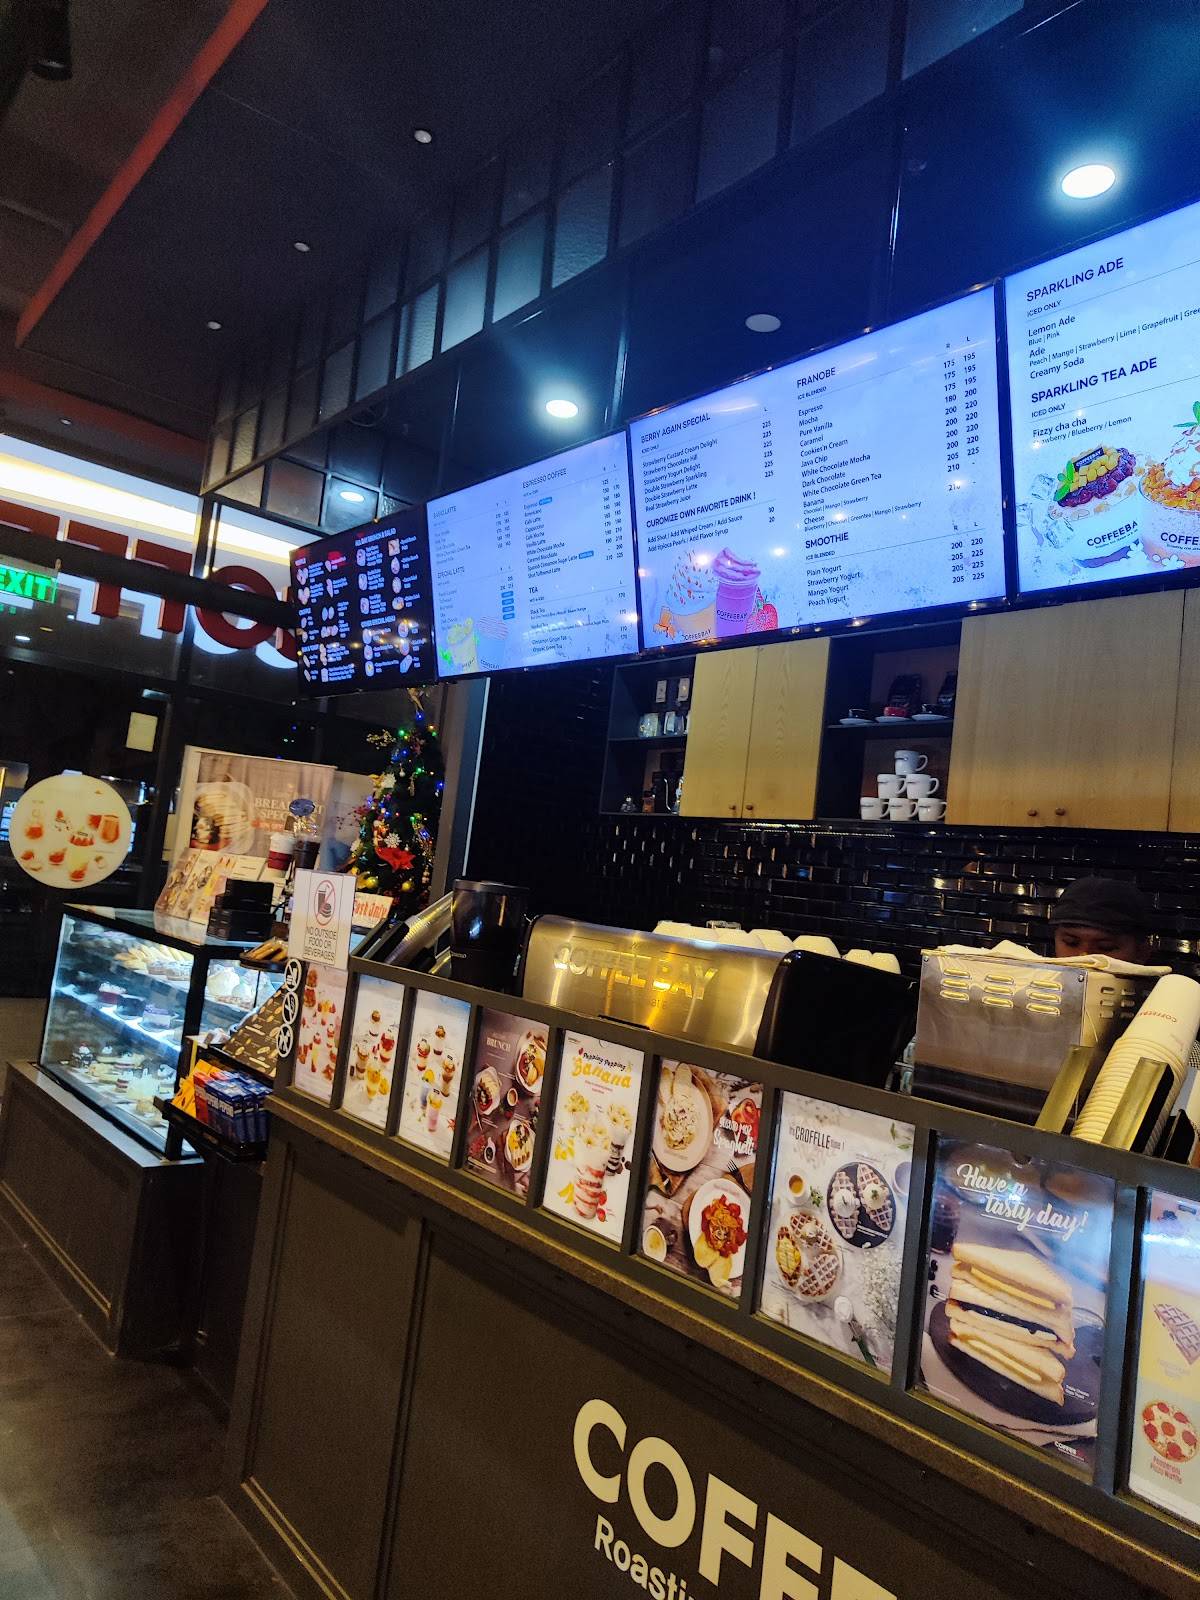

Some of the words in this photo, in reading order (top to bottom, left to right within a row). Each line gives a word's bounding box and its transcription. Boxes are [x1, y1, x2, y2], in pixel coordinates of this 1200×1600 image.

[1026, 269, 1095, 301] SPARKLING
[1097, 257, 1125, 277] ADE
[1027, 304, 1043, 317] ICED
[1043, 300, 1061, 311] ONLY
[1028, 322, 1057, 337] Lemon
[1058, 315, 1076, 327] Ade
[1028, 335, 1042, 346] Blue
[1046, 331, 1060, 341] Pink
[1029, 357, 1048, 367] Peach
[1052, 347, 1074, 360] Mango
[1078, 334, 1115, 351] Strawberry
[1119, 328, 1137, 338] Lime
[1141, 314, 1179, 332] Grapefruit
[1029, 347, 1046, 358] Ade
[1030, 363, 1061, 379] Creamy
[1063, 356, 1085, 370] Soda
[796, 367, 836, 388] FRANOBE
[798, 404, 823, 417] Espresso
[943, 360, 955, 369] 175
[963, 352, 976, 362] 195
[1031, 375, 1099, 403] SPARKLING
[1101, 367, 1127, 382] TEA
[1130, 357, 1157, 375] ADE
[799, 416, 818, 427] Mocha
[944, 371, 956, 380] 175
[964, 364, 976, 374] 195
[799, 428, 813, 437] Pure
[814, 421, 833, 433] Vanilla
[944, 383, 956, 392] 175
[964, 376, 977, 386] 195
[1031, 407, 1047, 418] ICED
[1048, 403, 1066, 413] ONLY
[641, 431, 660, 443] BERRY
[661, 423, 682, 436] AGAIN
[682, 413, 711, 428] SPECIAL
[800, 435, 824, 447] Caramel
[944, 394, 957, 403] 180
[964, 388, 977, 397] 200
[828, 439, 848, 449] Cream
[945, 406, 957, 415] 200
[965, 399, 978, 409] 220
[1032, 426, 1053, 438] Fizzy
[1055, 422, 1070, 431] cha
[1072, 417, 1087, 427] cha
[1071, 424, 1103, 437] Blueberry
[1108, 416, 1132, 426] Lemon
[801, 459, 814, 468] Java
[814, 455, 828, 466] Chip
[945, 418, 958, 427] 200
[965, 411, 978, 421] 220
[802, 467, 819, 478] White
[819, 460, 849, 474] Chocolate
[850, 454, 871, 465] Mocha
[946, 429, 958, 438] 200
[966, 423, 979, 433] 220
[802, 478, 816, 488] Dark
[816, 471, 846, 485] Chocolate
[946, 441, 959, 450] 200
[966, 435, 979, 445] 220
[802, 487, 820, 498] White
[820, 480, 850, 494] Chocolate
[850, 475, 870, 486] Green
[870, 472, 882, 482] Tea
[947, 452, 959, 461] 205
[967, 447, 980, 456] 225
[803, 498, 825, 508] Banana
[947, 463, 960, 472] 210
[843, 495, 869, 505] Strawberry
[680, 508, 696, 519] OWN
[697, 500, 729, 514] FAVORITE
[730, 494, 752, 505] DRINK
[803, 515, 825, 525] Cheese
[894, 500, 922, 512] Strawberry
[805, 532, 849, 549] SMOOTHIE
[807, 569, 821, 577] Plain
[822, 565, 842, 575] Yogurt
[951, 541, 962, 549] 200
[807, 575, 839, 587] Strawberry
[840, 571, 860, 581] Yogurt
[972, 549, 983, 557] 225
[529, 586, 538, 594] TEA
[807, 588, 828, 597] Mango
[828, 585, 849, 594] Yogurt
[952, 564, 963, 572] 205
[808, 598, 826, 607] Peach
[827, 595, 846, 604] Yogurt
[972, 572, 984, 580] 225
[306, 926, 314, 934] NO
[314, 927, 337, 940] OUTSIDE
[308, 936, 323, 948] FOOD
[324, 940, 331, 948] OR
[304, 946, 336, 961] BEVERAGES
[487, 1036, 510, 1052] BRUNCH
[572, 1056, 632, 1088] Banana
[956, 1163, 1007, 1193] Have
[1011, 1181, 1028, 1198] a
[985, 1192, 1035, 1231] tasty
[1036, 1202, 1089, 1242] day!
[573, 1399, 898, 1600] COFF
